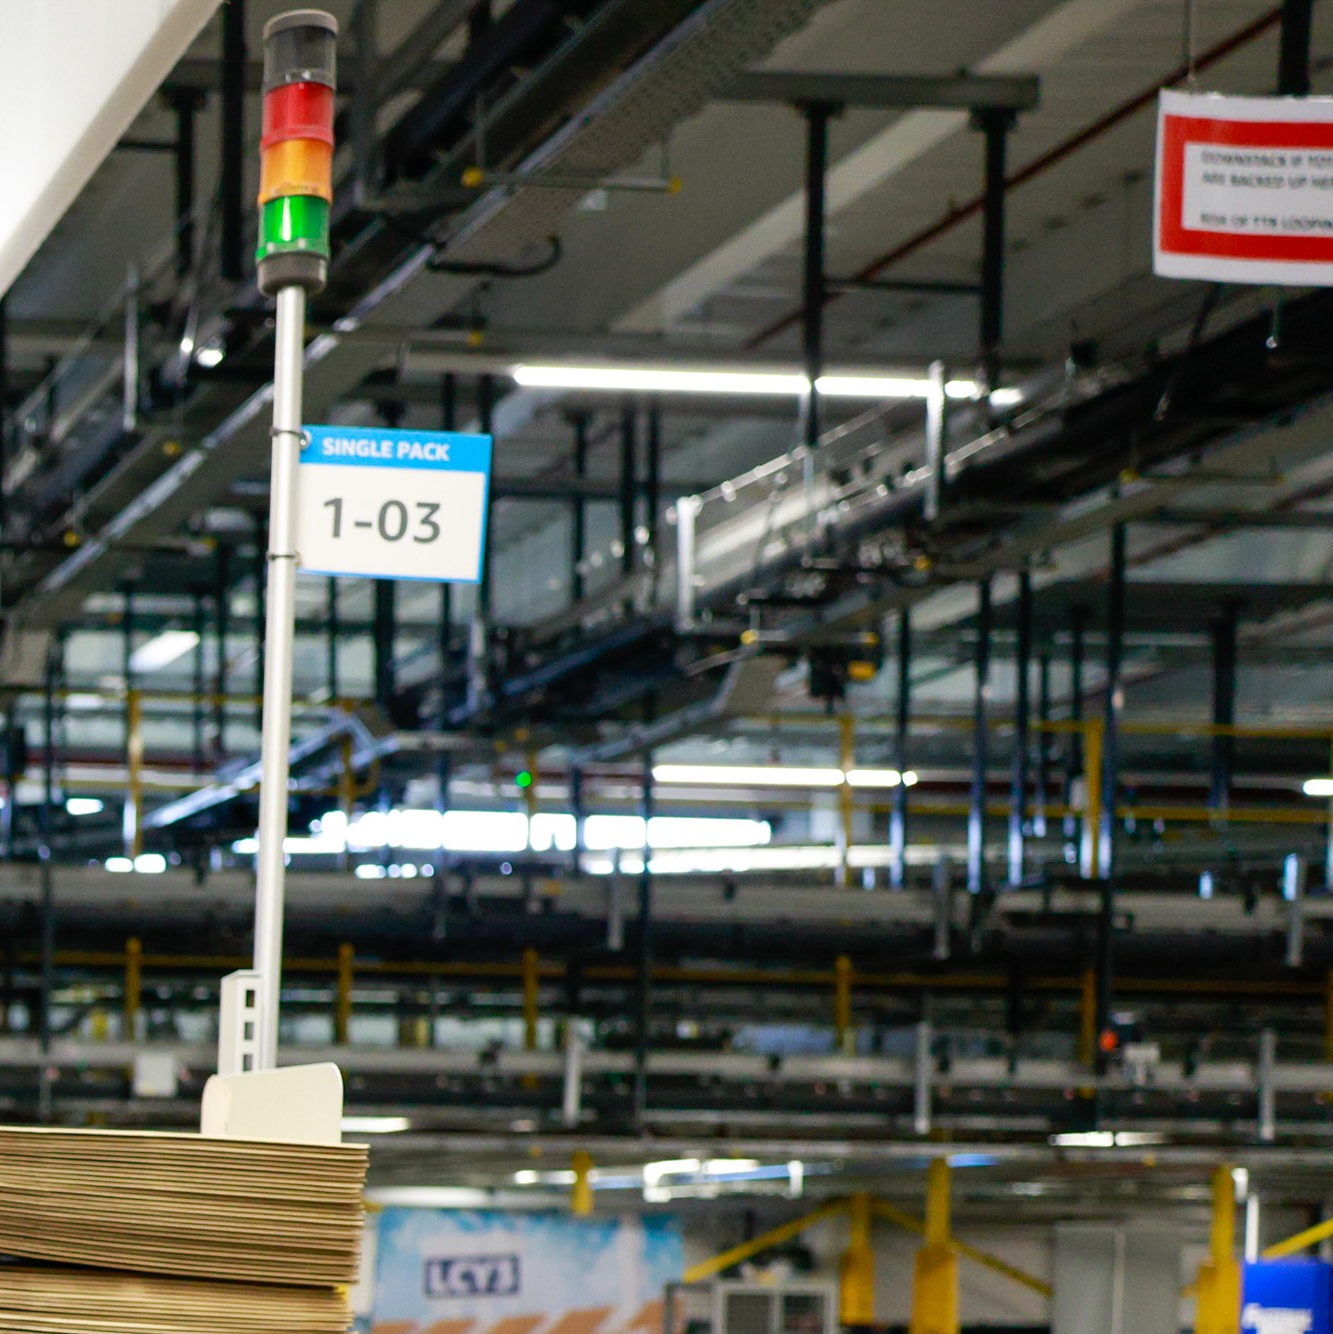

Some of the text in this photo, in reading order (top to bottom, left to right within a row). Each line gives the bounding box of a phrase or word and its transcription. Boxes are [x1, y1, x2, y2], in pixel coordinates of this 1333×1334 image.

[322, 436, 450, 462] SINGLE PACK
[323, 497, 442, 544] 1-03
